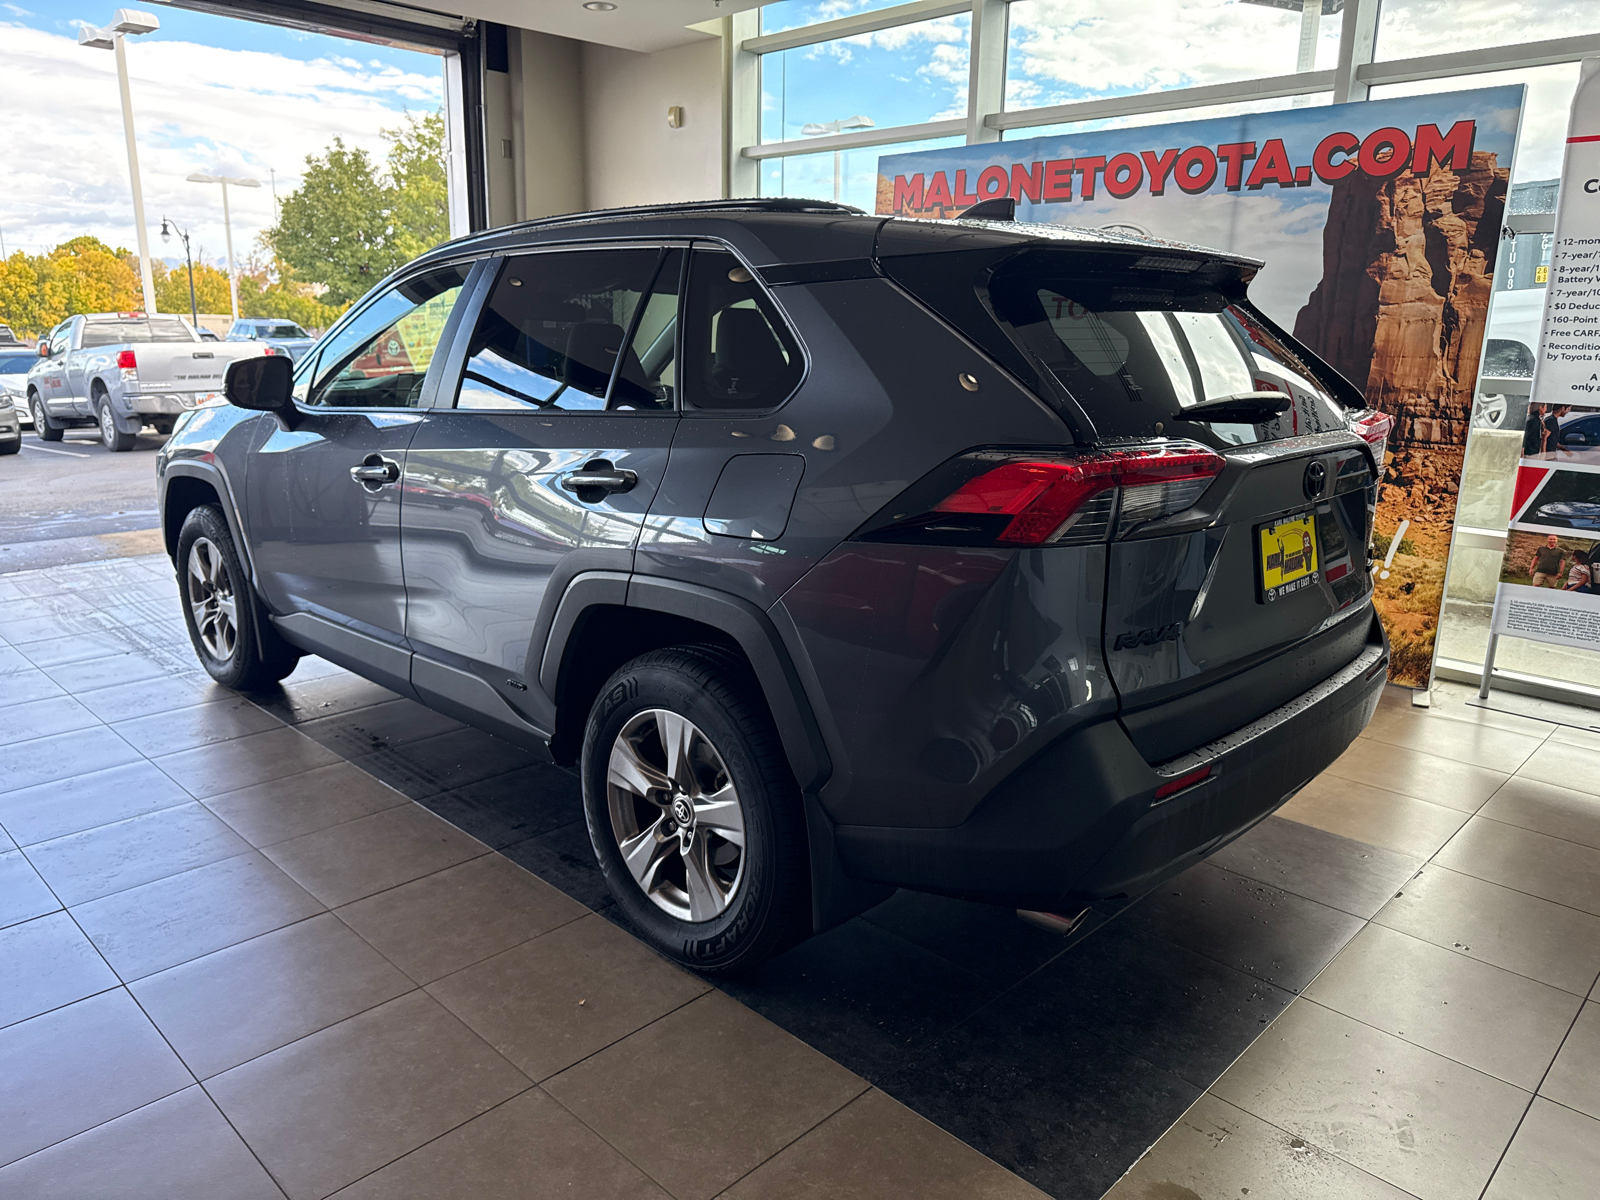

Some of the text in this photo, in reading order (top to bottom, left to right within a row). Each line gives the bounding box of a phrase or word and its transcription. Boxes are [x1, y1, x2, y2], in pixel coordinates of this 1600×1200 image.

[893, 119, 1476, 212] MALONETOYOTA.COM
[1557, 275, 1594, 284] Battery
[1554, 302, 1567, 310] $0
[1552, 316, 1598, 324] 160-Point
[1550, 329, 1600, 337] Free CARF
[1546, 352, 1559, 361] by
[1561, 353, 1592, 362] Toyota
[1589, 373, 1598, 381] A
[1571, 383, 1594, 393] only
[1112, 621, 1181, 652] RAV4
